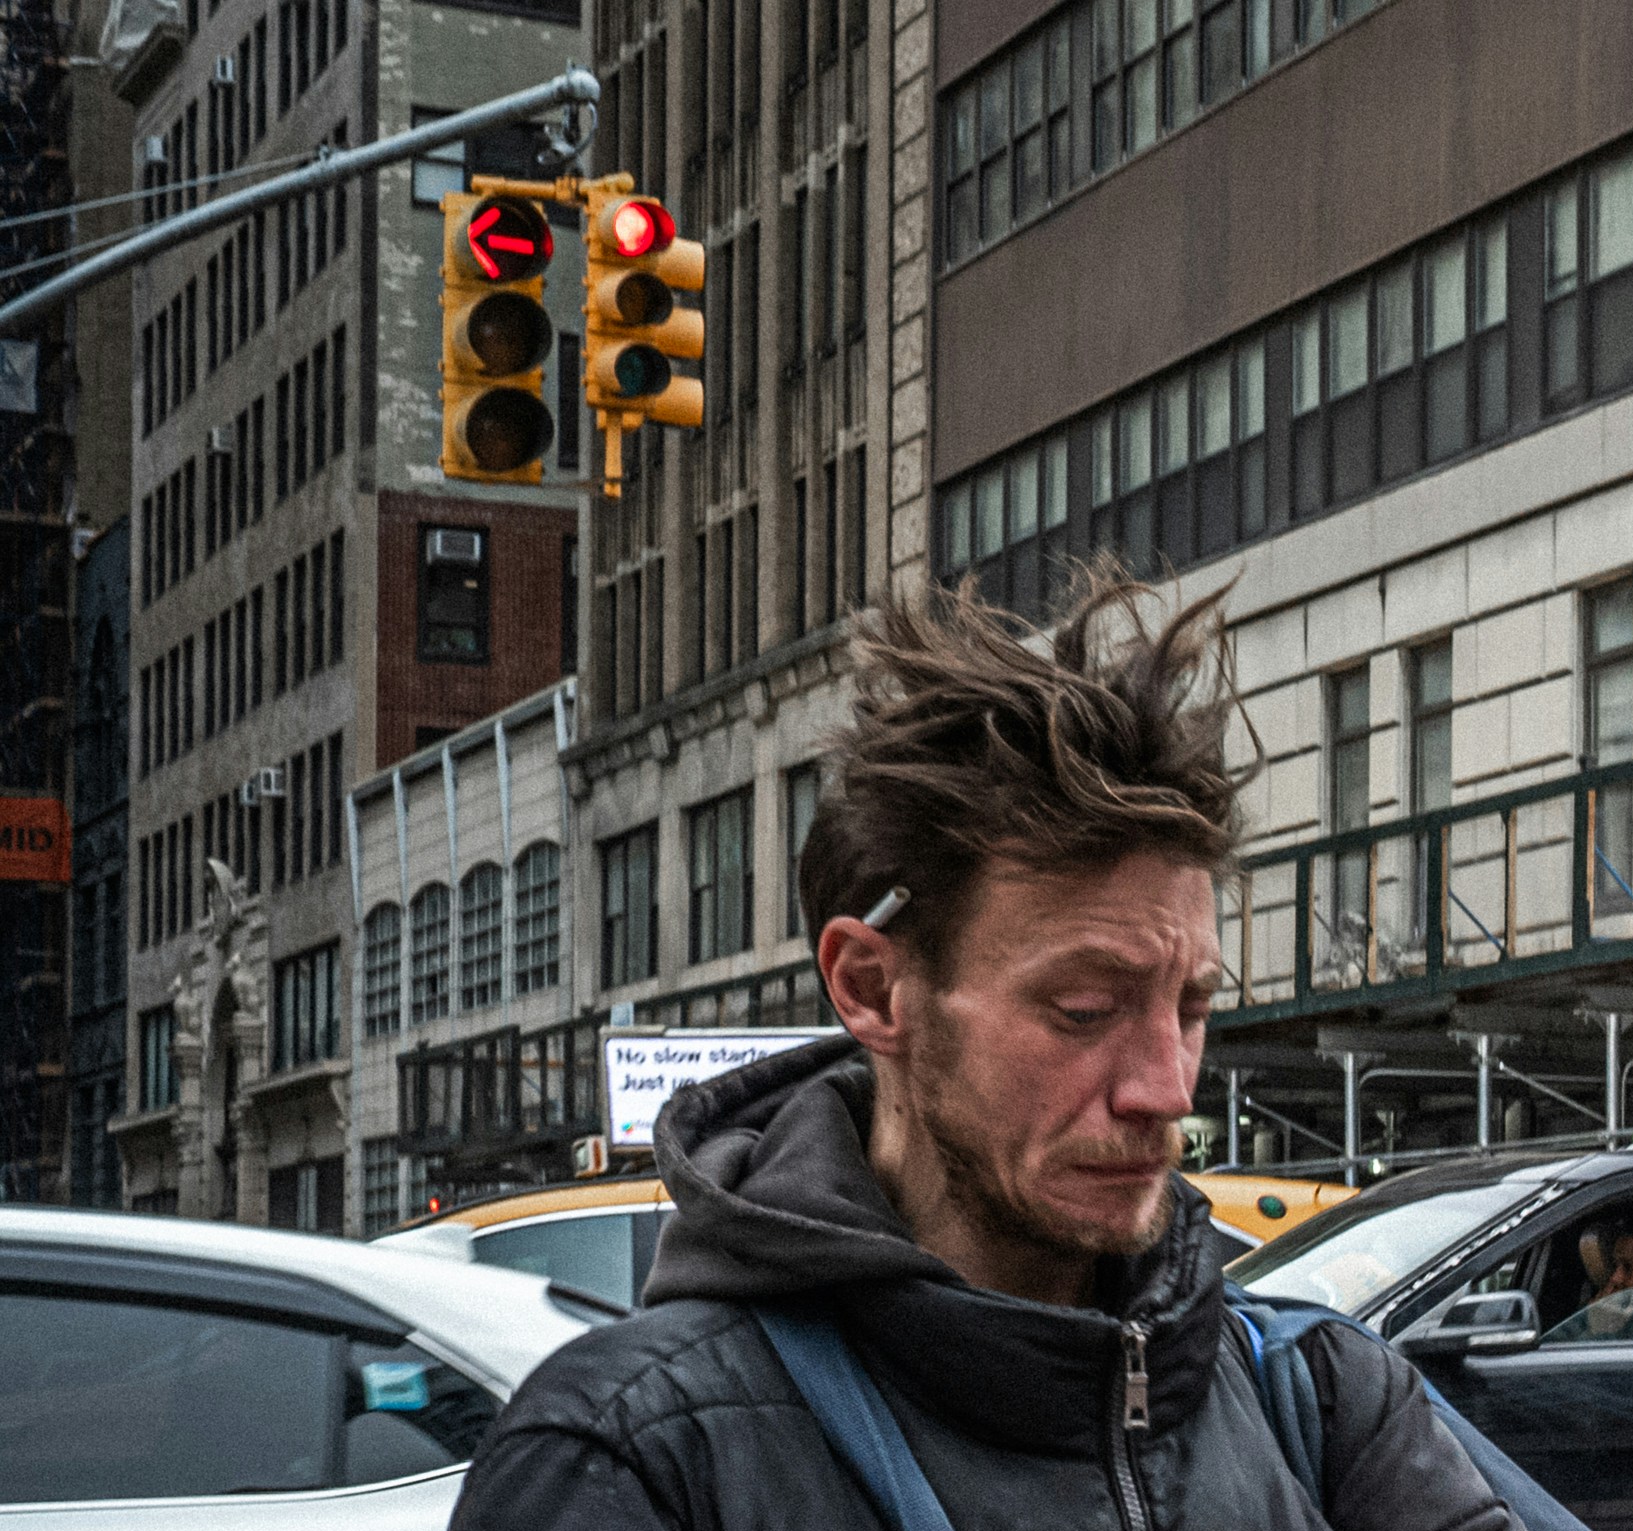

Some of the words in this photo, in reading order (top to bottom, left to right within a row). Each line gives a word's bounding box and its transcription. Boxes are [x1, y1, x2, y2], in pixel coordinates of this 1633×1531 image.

[616, 1047, 646, 1065] No
[654, 1046, 701, 1064] slow
[620, 1073, 664, 1092] Just
